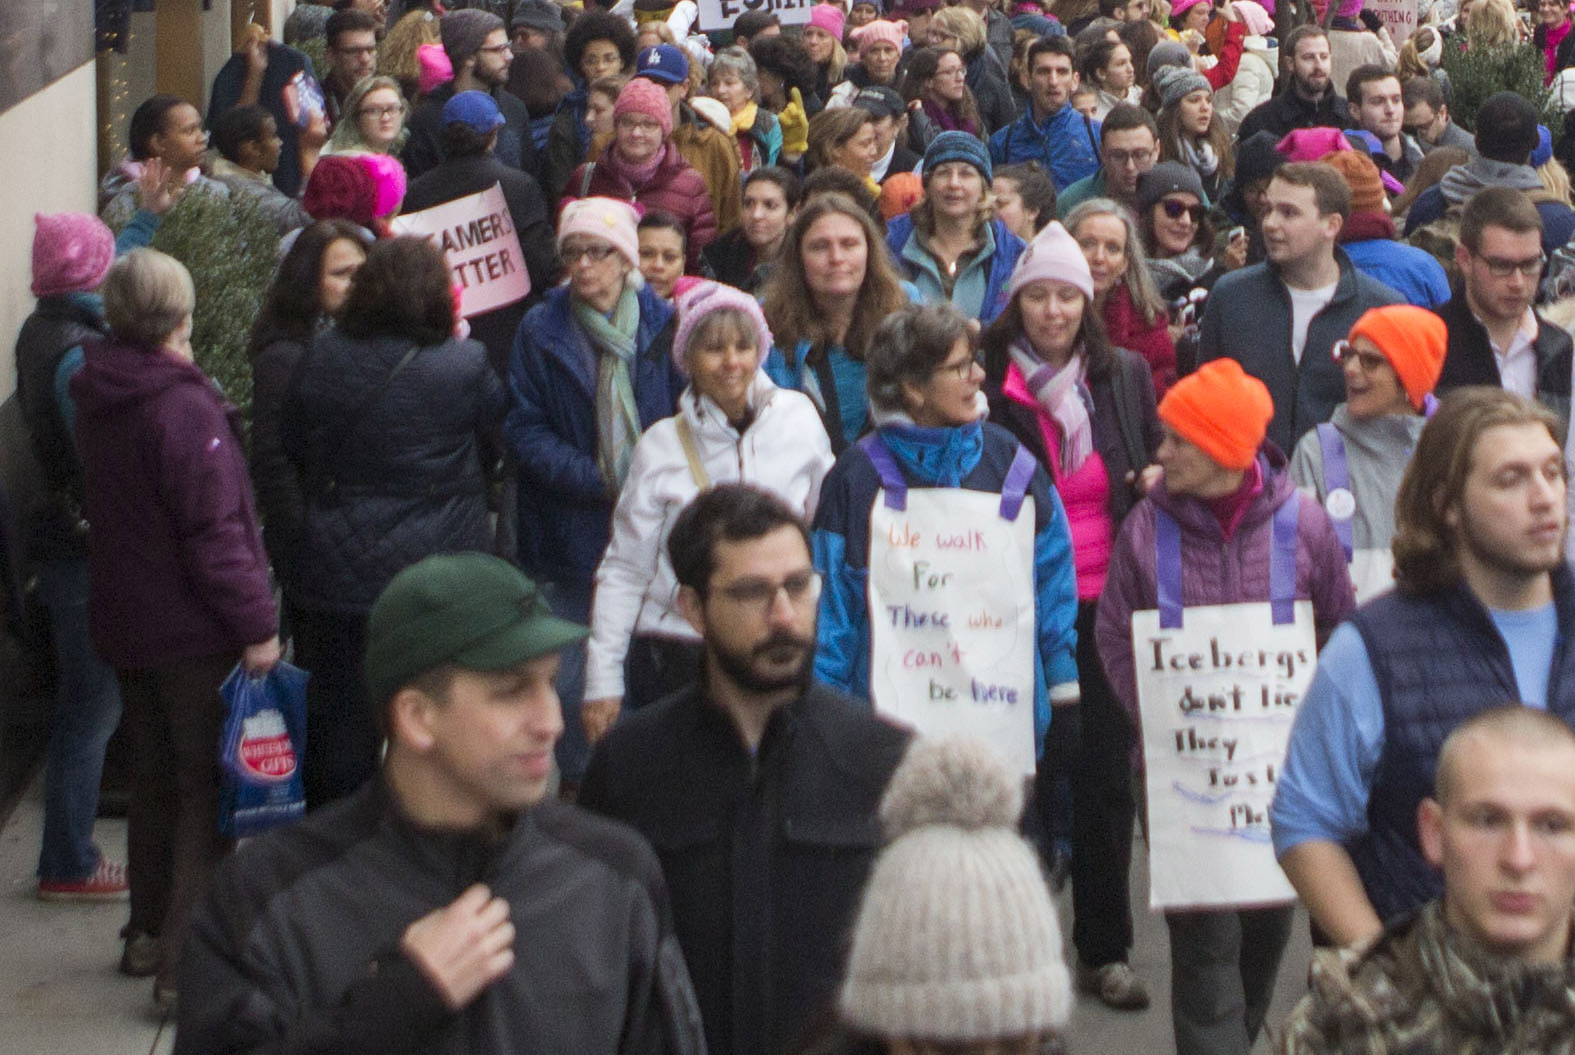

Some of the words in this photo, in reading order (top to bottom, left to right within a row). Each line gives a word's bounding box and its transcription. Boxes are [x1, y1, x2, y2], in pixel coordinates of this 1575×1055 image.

[888, 522, 921, 547] We
[936, 530, 988, 551] walk
[912, 561, 955, 591] For
[968, 610, 1004, 631] who
[903, 643, 965, 670] can't
[1148, 634, 1309, 680] Icebergs
[929, 679, 959, 702] be
[970, 677, 1019, 705] here
[1261, 684, 1299, 709] lie
